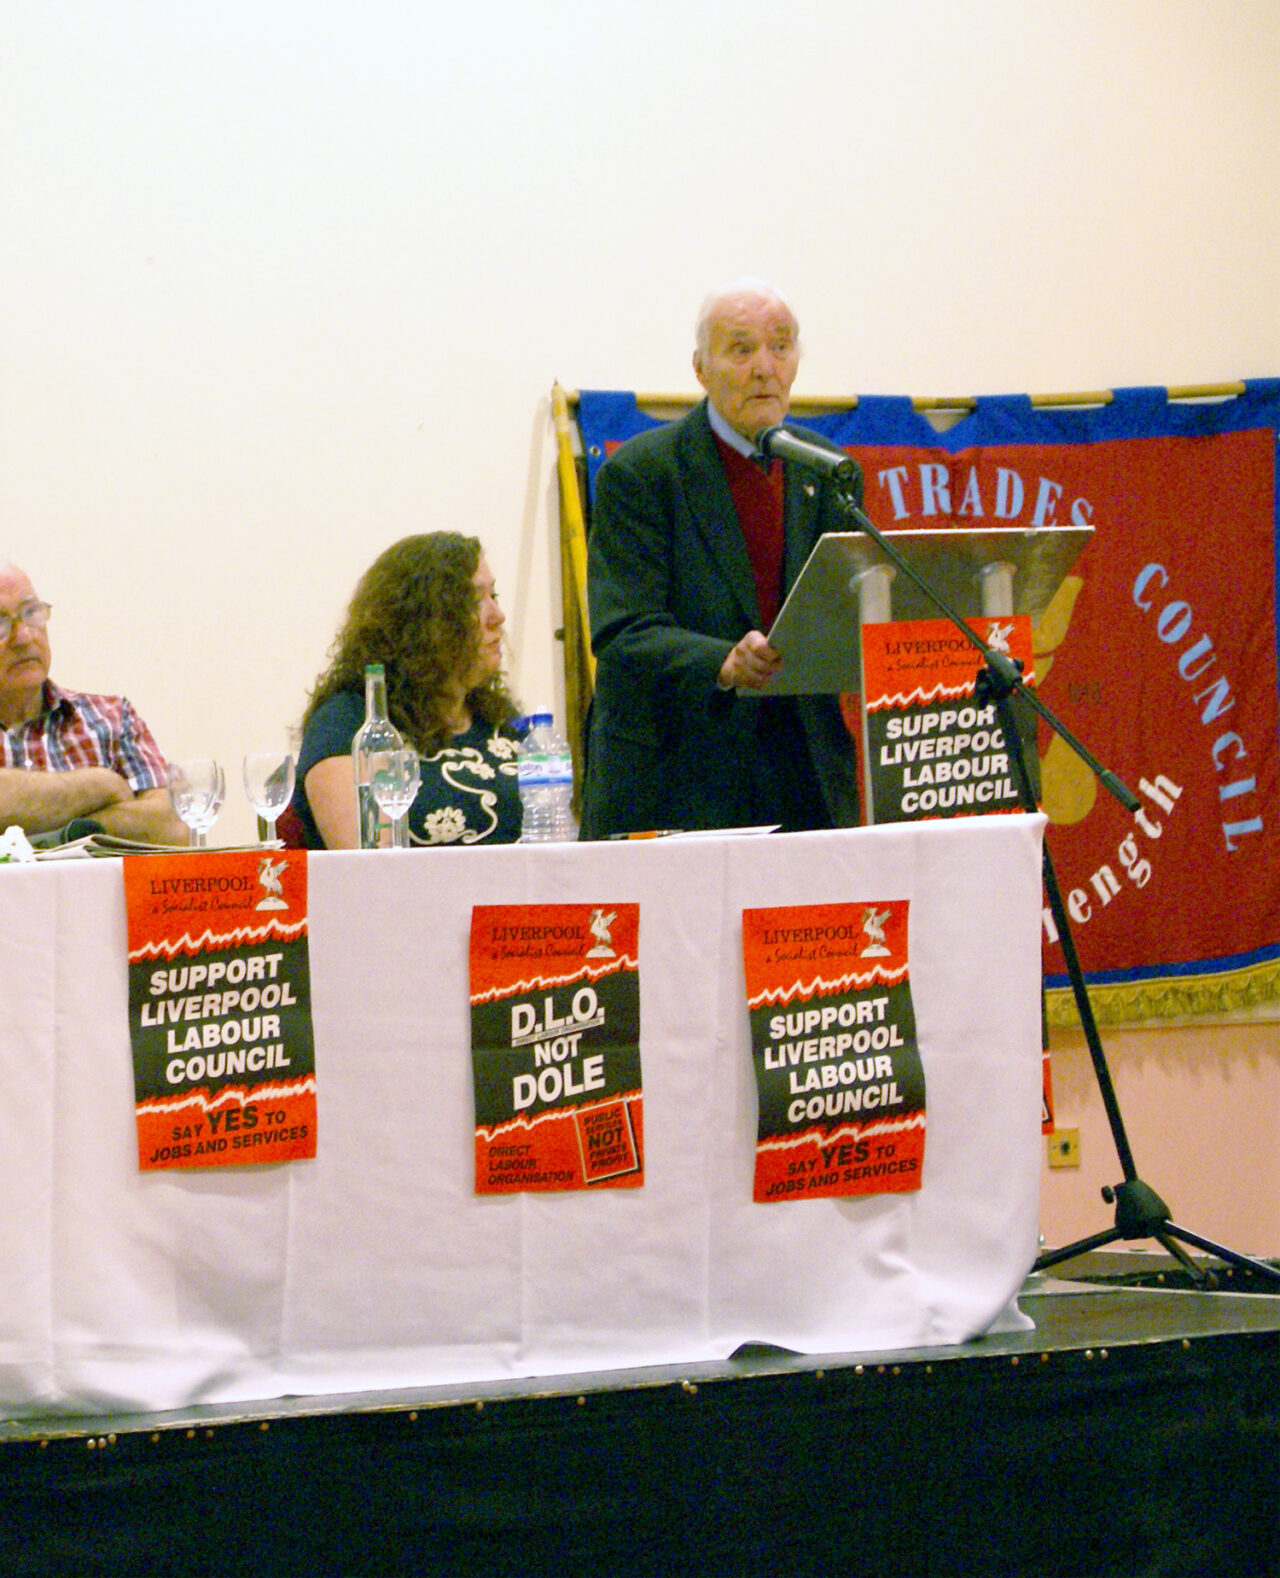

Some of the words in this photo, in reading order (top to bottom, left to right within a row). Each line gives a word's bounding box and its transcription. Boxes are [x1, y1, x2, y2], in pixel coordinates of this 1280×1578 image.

[878, 463, 1095, 527] TRADES
[885, 639, 981, 656] LIVERPOO
[886, 704, 996, 739] SUPPOR
[1133, 563, 1264, 852] COUNCIL
[880, 728, 1006, 766] LIVERPOO
[903, 753, 1009, 788] LABOUR
[901, 778, 1018, 814] COUNCIL
[1041, 774, 1183, 943] rength
[150, 876, 254, 895] LIVERPOOL
[161, 898, 208, 914] Socialist
[210, 896, 253, 911] Council
[491, 926, 585, 941] LIVERPOOL
[545, 943, 585, 957] Council
[763, 925, 859, 945] LIVERPOOL
[774, 948, 817, 963] Socialist
[819, 945, 858, 959] Council
[149, 953, 283, 996] SUPPORT
[141, 982, 297, 1027] LIVERPOOL
[512, 987, 605, 1038] D.L.O.
[769, 997, 889, 1040] SUPPORT
[167, 1014, 281, 1053] LABOUR
[534, 1032, 582, 1067] NOT
[764, 1024, 904, 1070] LIVERPOOL
[166, 1044, 291, 1084] COUNCIL
[789, 1055, 893, 1094] LABOUR
[513, 1054, 606, 1111] DOLE
[787, 1082, 903, 1123] COUNCIL
[172, 1124, 203, 1141] SAY
[206, 1106, 258, 1134] YES
[265, 1110, 286, 1125] TO
[588, 1126, 624, 1149] NOT
[150, 1144, 191, 1163] JOBS
[194, 1139, 228, 1156] AND
[232, 1125, 308, 1149] SERVICES
[488, 1145, 531, 1157] DIRECT
[787, 1158, 817, 1176] SAY
[820, 1140, 869, 1169] YES
[876, 1145, 896, 1159] TO
[488, 1158, 537, 1171] LABOUR
[488, 1169, 574, 1185] ORGANISATION
[766, 1178, 805, 1196] JOBS
[807, 1172, 839, 1188] AND
[843, 1158, 917, 1182] SERVICES
